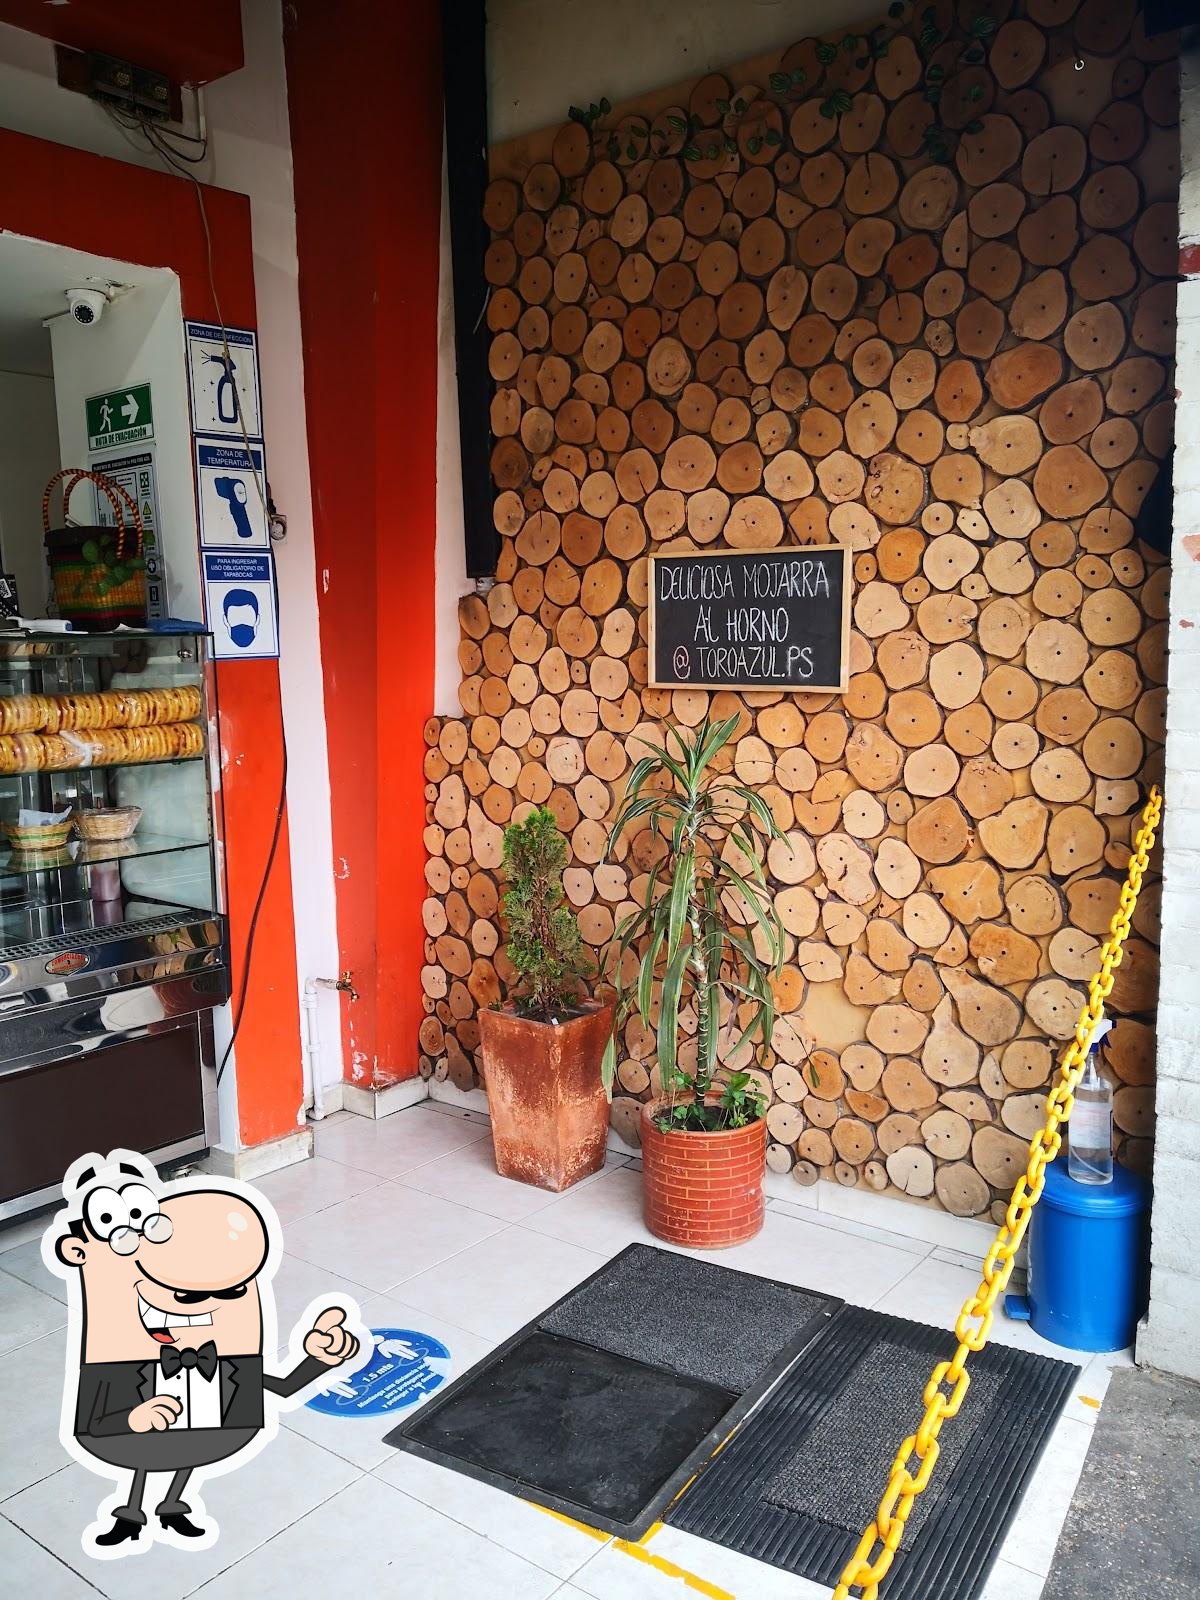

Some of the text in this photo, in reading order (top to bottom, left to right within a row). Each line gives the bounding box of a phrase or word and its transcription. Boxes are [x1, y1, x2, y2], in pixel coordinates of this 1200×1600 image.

[190, 328, 206, 336] ZONA
[95, 436, 108, 447] RUTA
[108, 433, 115, 444] DE
[216, 449, 234, 457] ZONA
[660, 561, 830, 601] DELICIOSA MOJARRA
[694, 604, 789, 643] AL HORNO
[696, 645, 814, 679] TOROAZUL.PS
